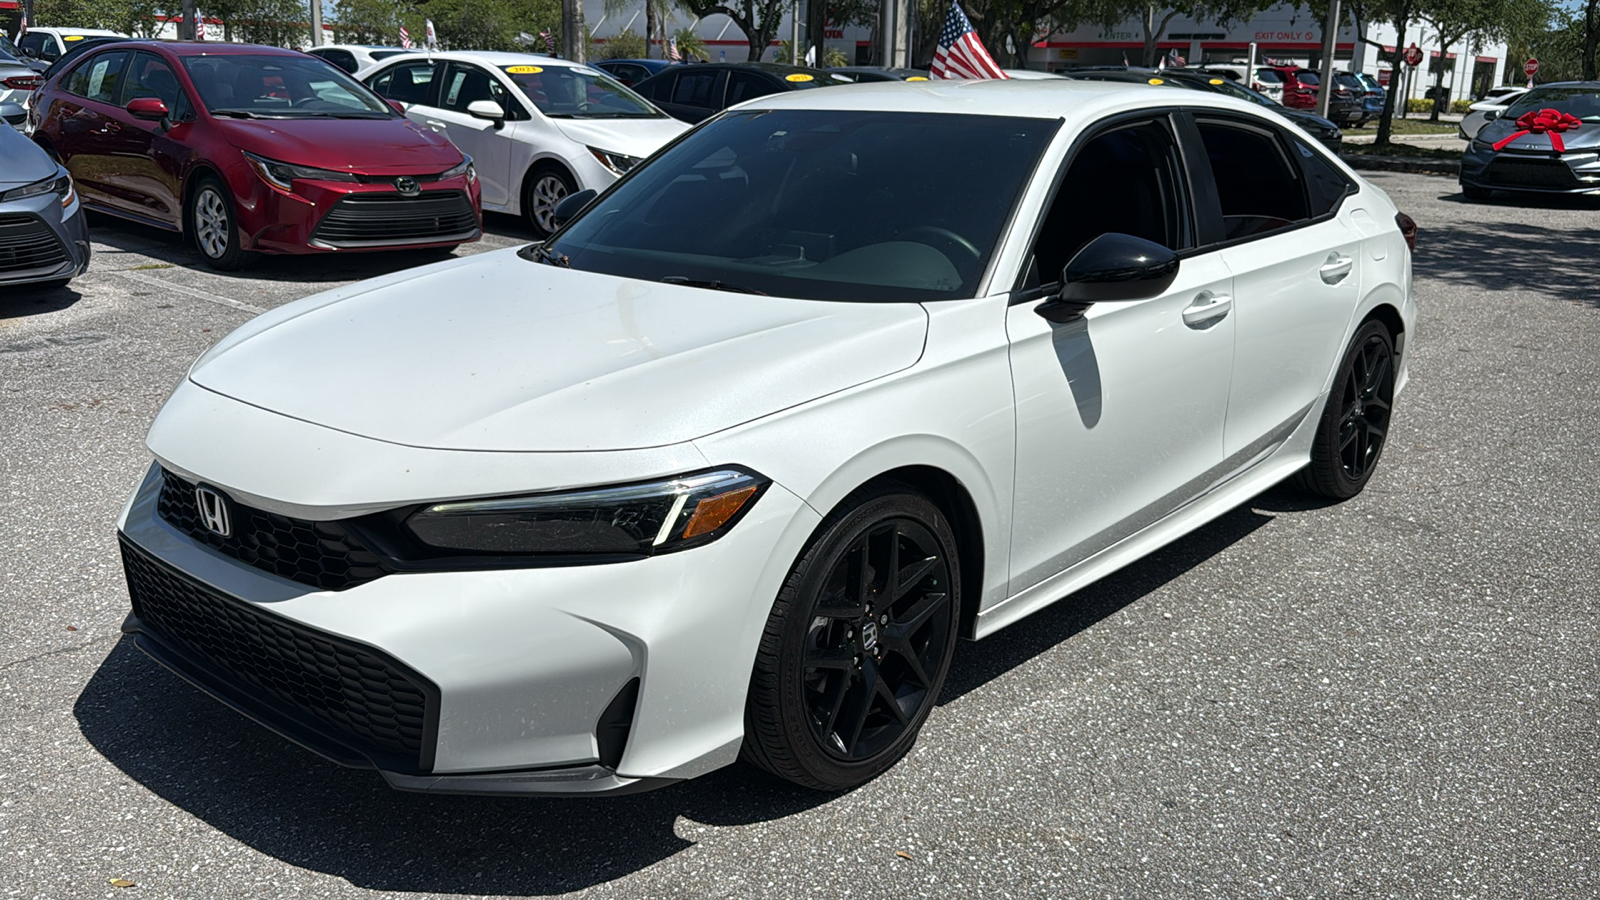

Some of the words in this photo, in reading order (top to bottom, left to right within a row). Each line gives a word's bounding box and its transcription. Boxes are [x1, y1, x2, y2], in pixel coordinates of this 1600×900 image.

[1104, 32, 1132, 40] ENTER
[1254, 31, 1275, 40] EXIT
[1276, 31, 1302, 40] ONLY
